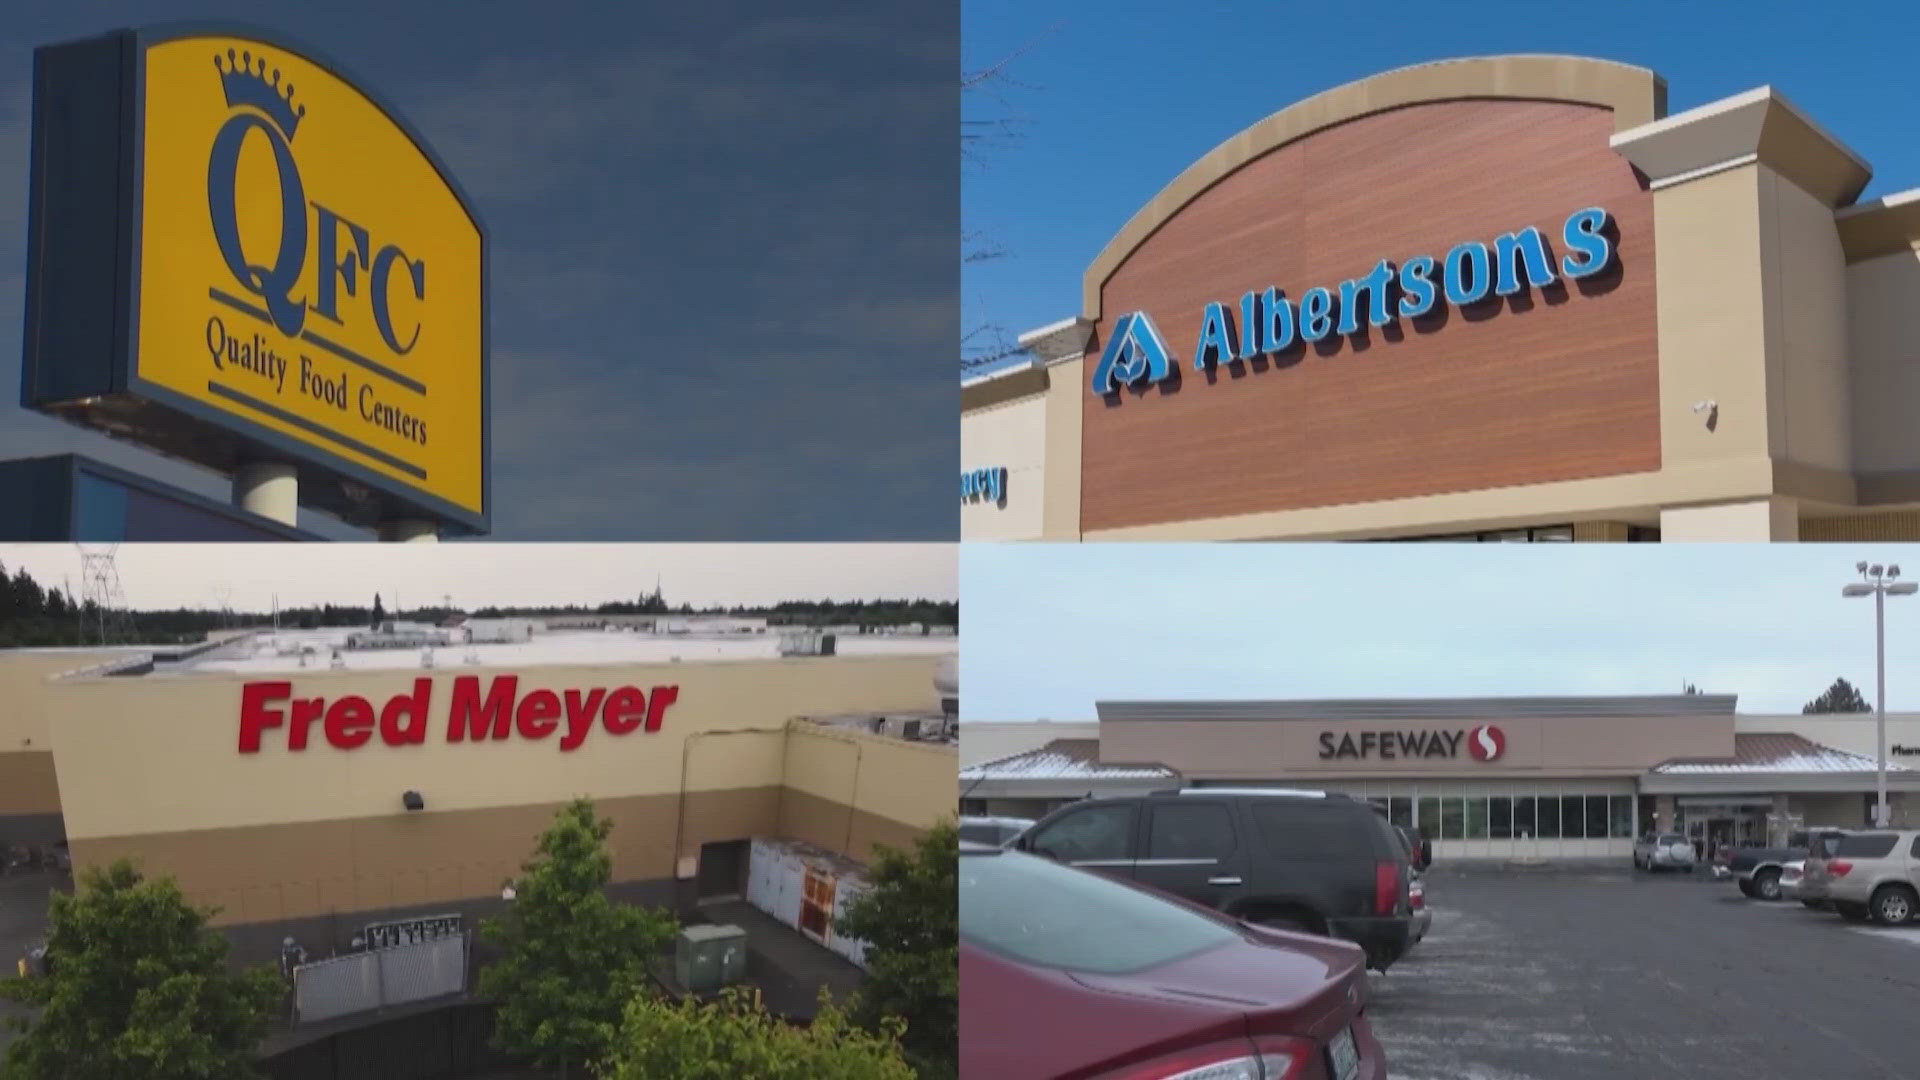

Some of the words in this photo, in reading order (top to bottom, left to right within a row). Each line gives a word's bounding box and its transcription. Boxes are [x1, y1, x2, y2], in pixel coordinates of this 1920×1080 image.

[207, 113, 424, 355] QFC
[1194, 207, 1612, 371] Albertsons
[206, 316, 287, 394] Quality
[299, 354, 348, 410] Food
[359, 385, 428, 446] Centers
[238, 677, 433, 754] Fred
[446, 674, 679, 752] Meyer
[1319, 730, 1464, 760] SAFEWAY
